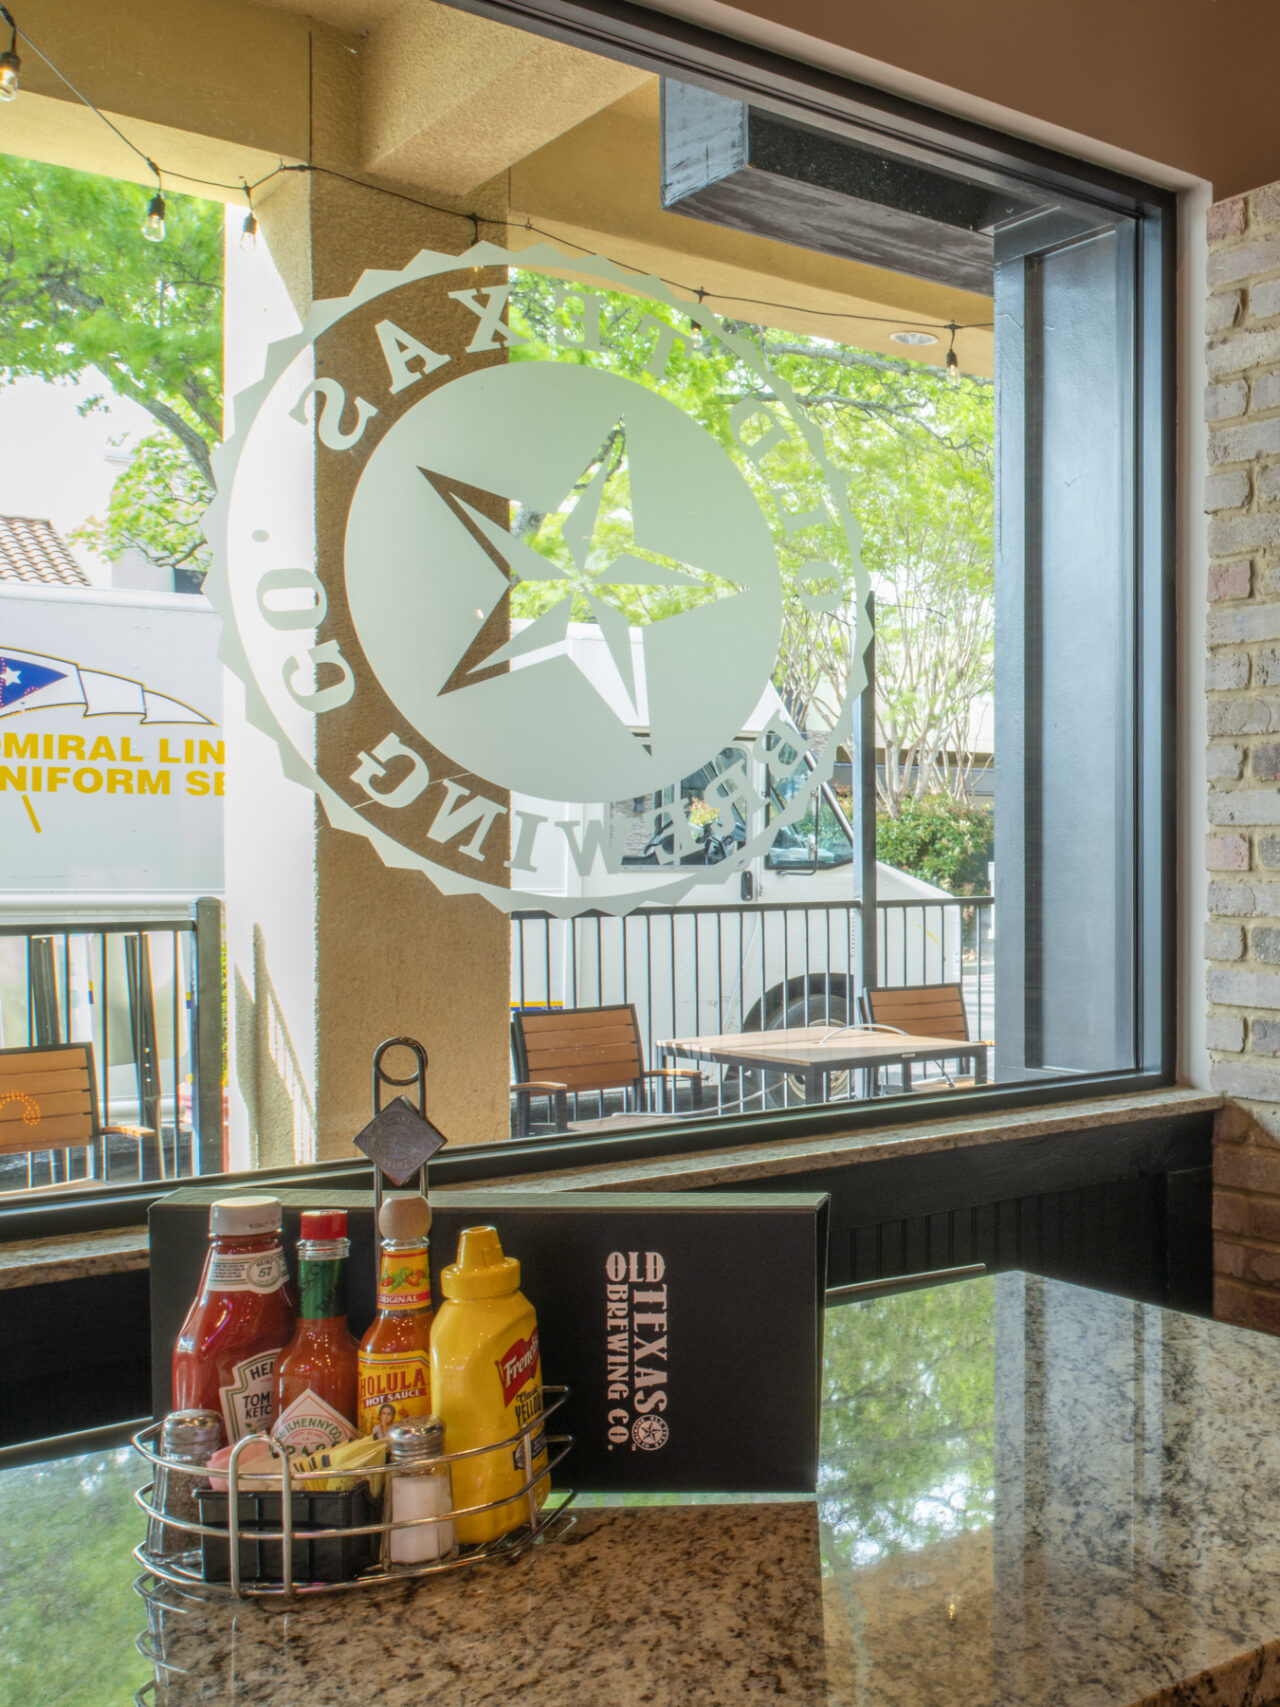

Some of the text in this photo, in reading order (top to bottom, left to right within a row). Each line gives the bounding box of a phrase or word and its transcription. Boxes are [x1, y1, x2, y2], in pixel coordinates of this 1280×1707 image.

[0, 732, 143, 762] MIRAL
[0, 765, 170, 795] NIFORM
[258, 1266, 273, 1278] 57
[605, 1251, 666, 1283] OLD
[379, 1294, 418, 1304] ORIGINAL
[633, 1284, 668, 1414] TEXAS
[606, 1284, 629, 1451] BREWING CO.
[358, 1368, 426, 1400] HOLULA
[366, 1389, 420, 1407] HOT SAUCE
